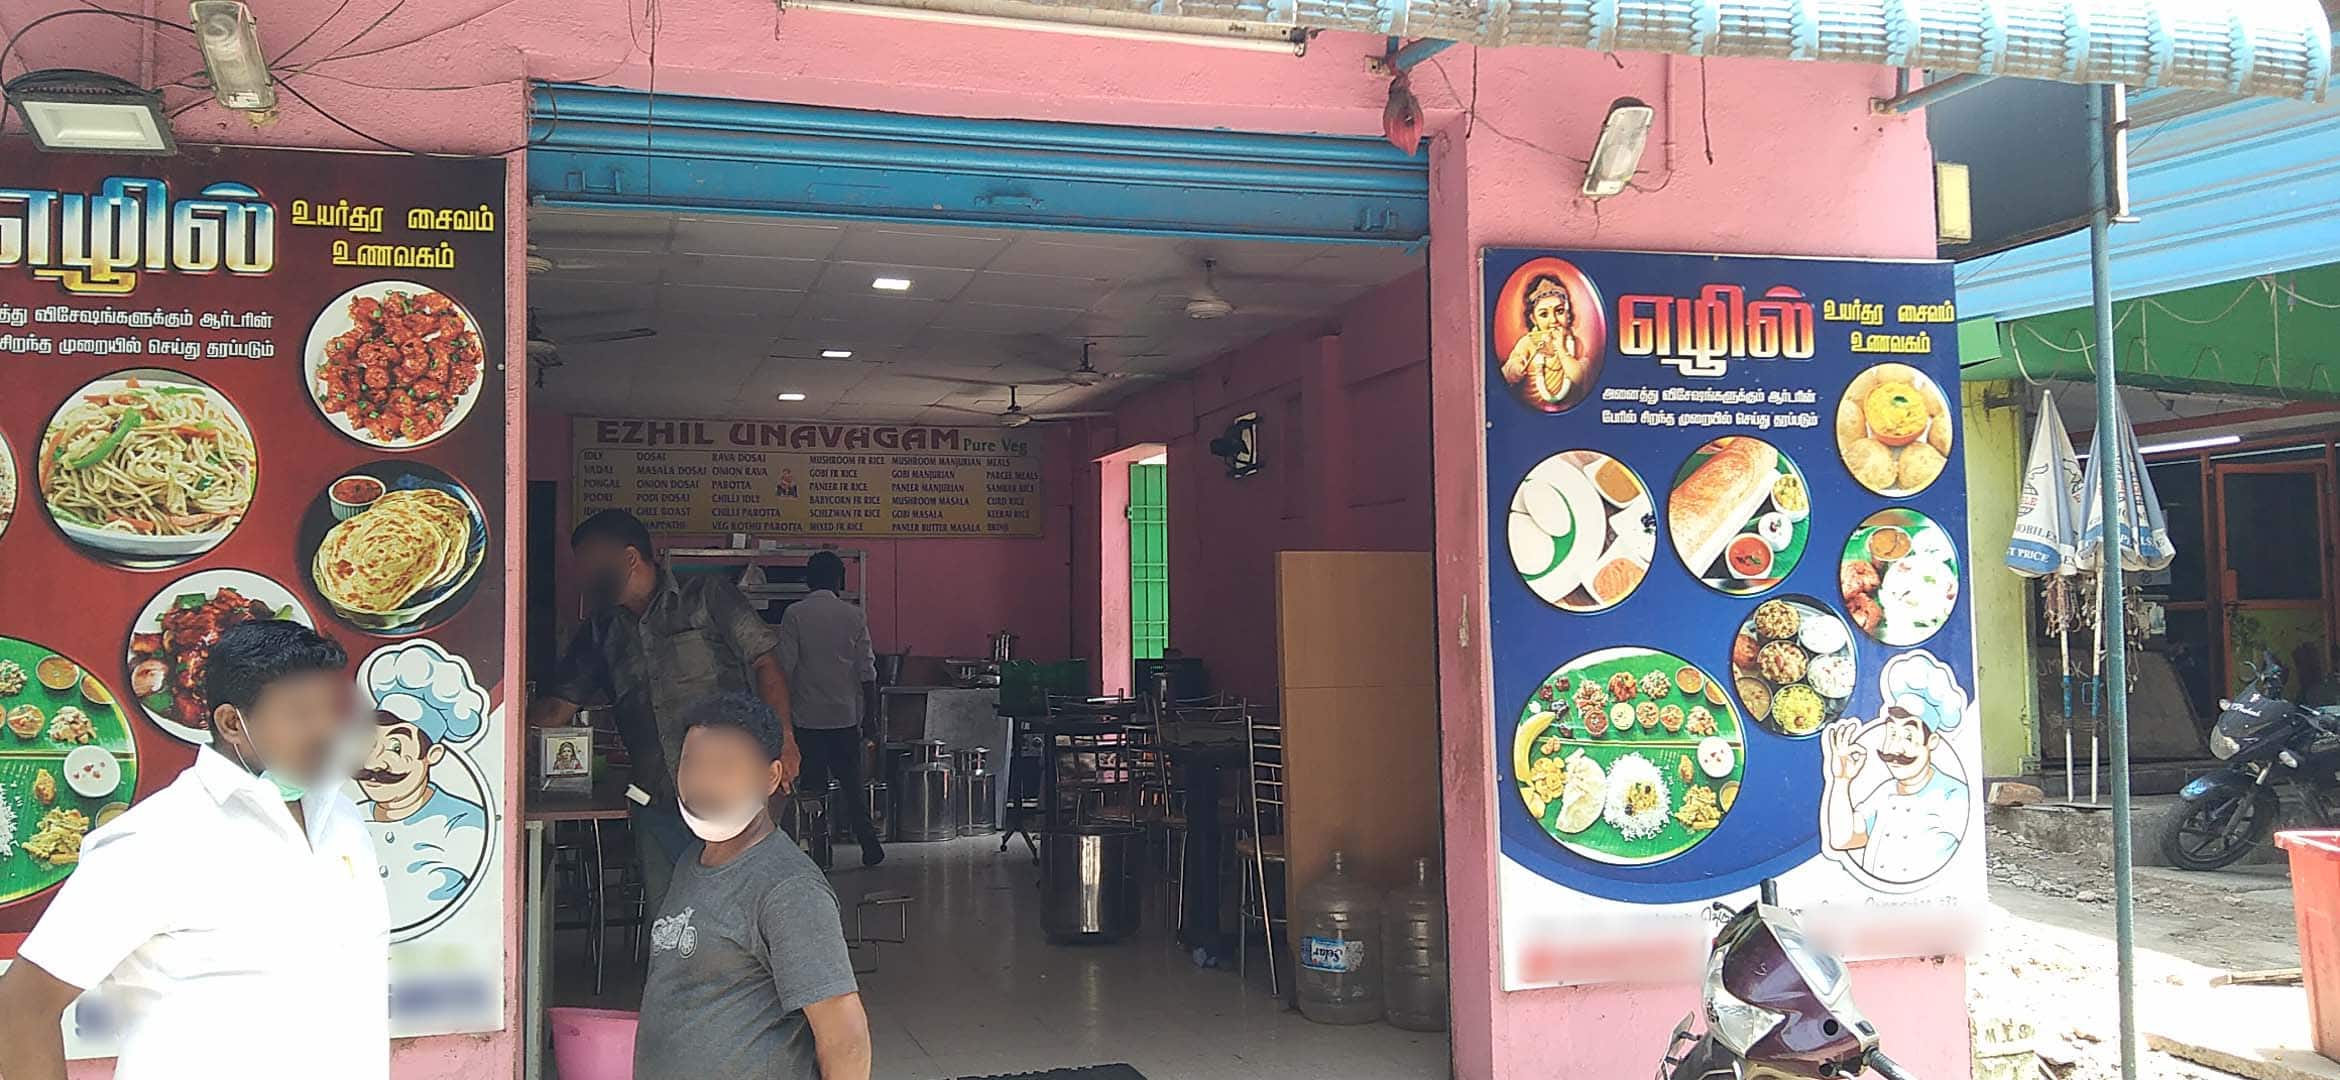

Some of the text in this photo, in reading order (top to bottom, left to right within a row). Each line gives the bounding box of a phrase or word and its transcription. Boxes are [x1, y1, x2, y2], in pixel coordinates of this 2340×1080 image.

[292, 199, 495, 234] உயர்தர சைவம்
[333, 240, 455, 269] உணவகம்
[1824, 299, 1956, 325] உயர்தர சைவம்
[199, 311, 274, 330] ஆர்டரின்
[1618, 284, 1815, 378] எழில்
[1851, 331, 1932, 354] உணவகம்
[59, 336, 142, 355] முறையில்
[148, 338, 200, 360] செய்து
[206, 340, 275, 358] தரப்படும்
[597, 420, 959, 451] EZHIL UNAVAGAM
[963, 437, 1029, 456] Pure Veg
[809, 456, 856, 465] MUSHROOM
[868, 456, 885, 465] RICE
[891, 457, 936, 466] MUSHROOM
[636, 465, 706, 475] MASALA DOSAI
[711, 467, 742, 476] ONION
[809, 469, 828, 478] GOBI
[841, 469, 858, 478] RICE
[891, 470, 909, 479] GOBI
[636, 479, 699, 489] ONION DOSAI
[711, 480, 752, 489] PAROTTA
[809, 483, 838, 491] PANEER
[851, 483, 868, 491] RICE
[891, 483, 919, 492] PANEER
[864, 496, 880, 505] RICE
[891, 496, 936, 505] MUSHROOM
[864, 509, 880, 518] RICE
[891, 510, 910, 518] GOBI
[891, 523, 920, 532] PANEER
[2017, 549, 2050, 563] PRICE
